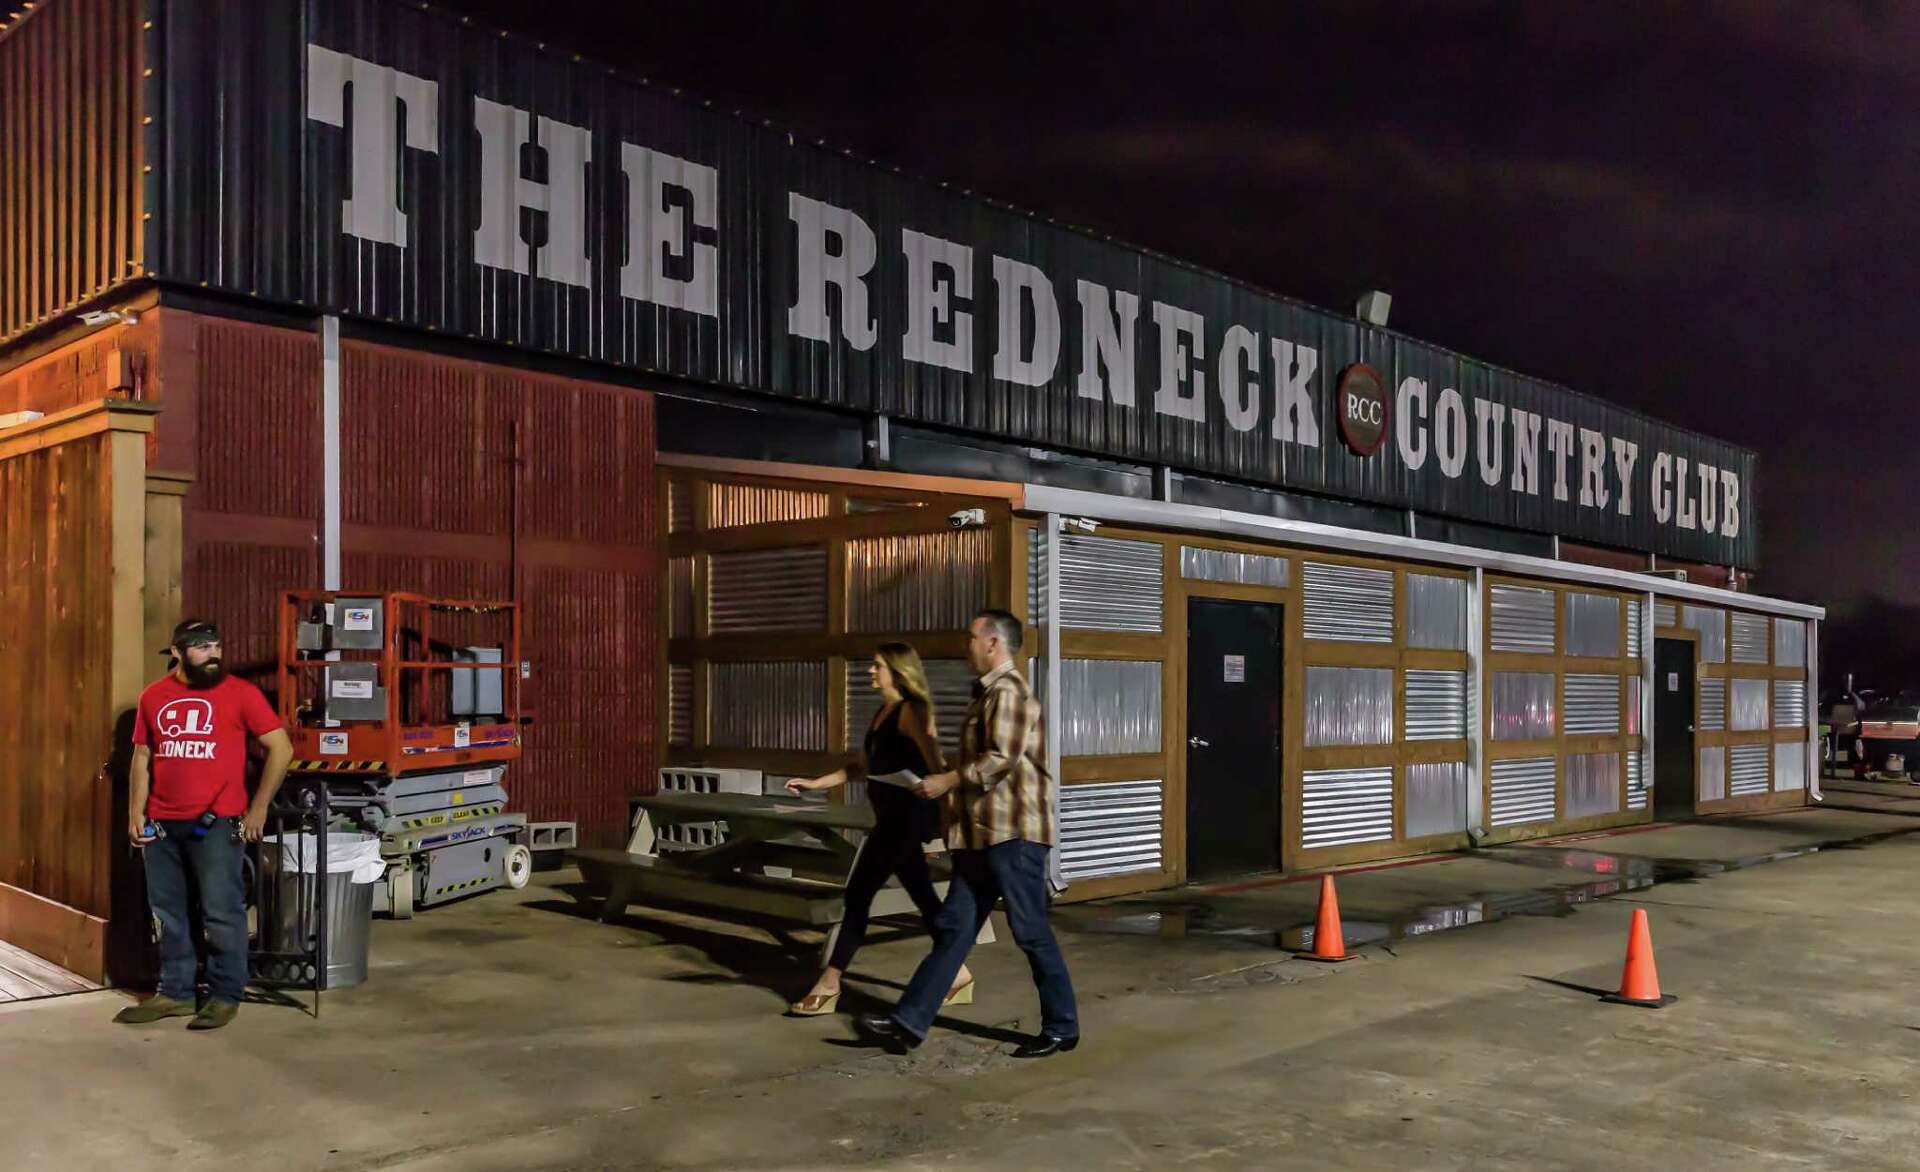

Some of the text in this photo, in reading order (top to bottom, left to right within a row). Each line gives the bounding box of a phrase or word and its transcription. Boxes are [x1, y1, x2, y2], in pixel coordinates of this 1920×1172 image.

[307, 43, 1740, 538] THE REDNECK COUNTRY CLUB
[1347, 392, 1381, 425] RCC
[157, 740, 217, 759] DNECK
[451, 826, 486, 840] SKYJACK
